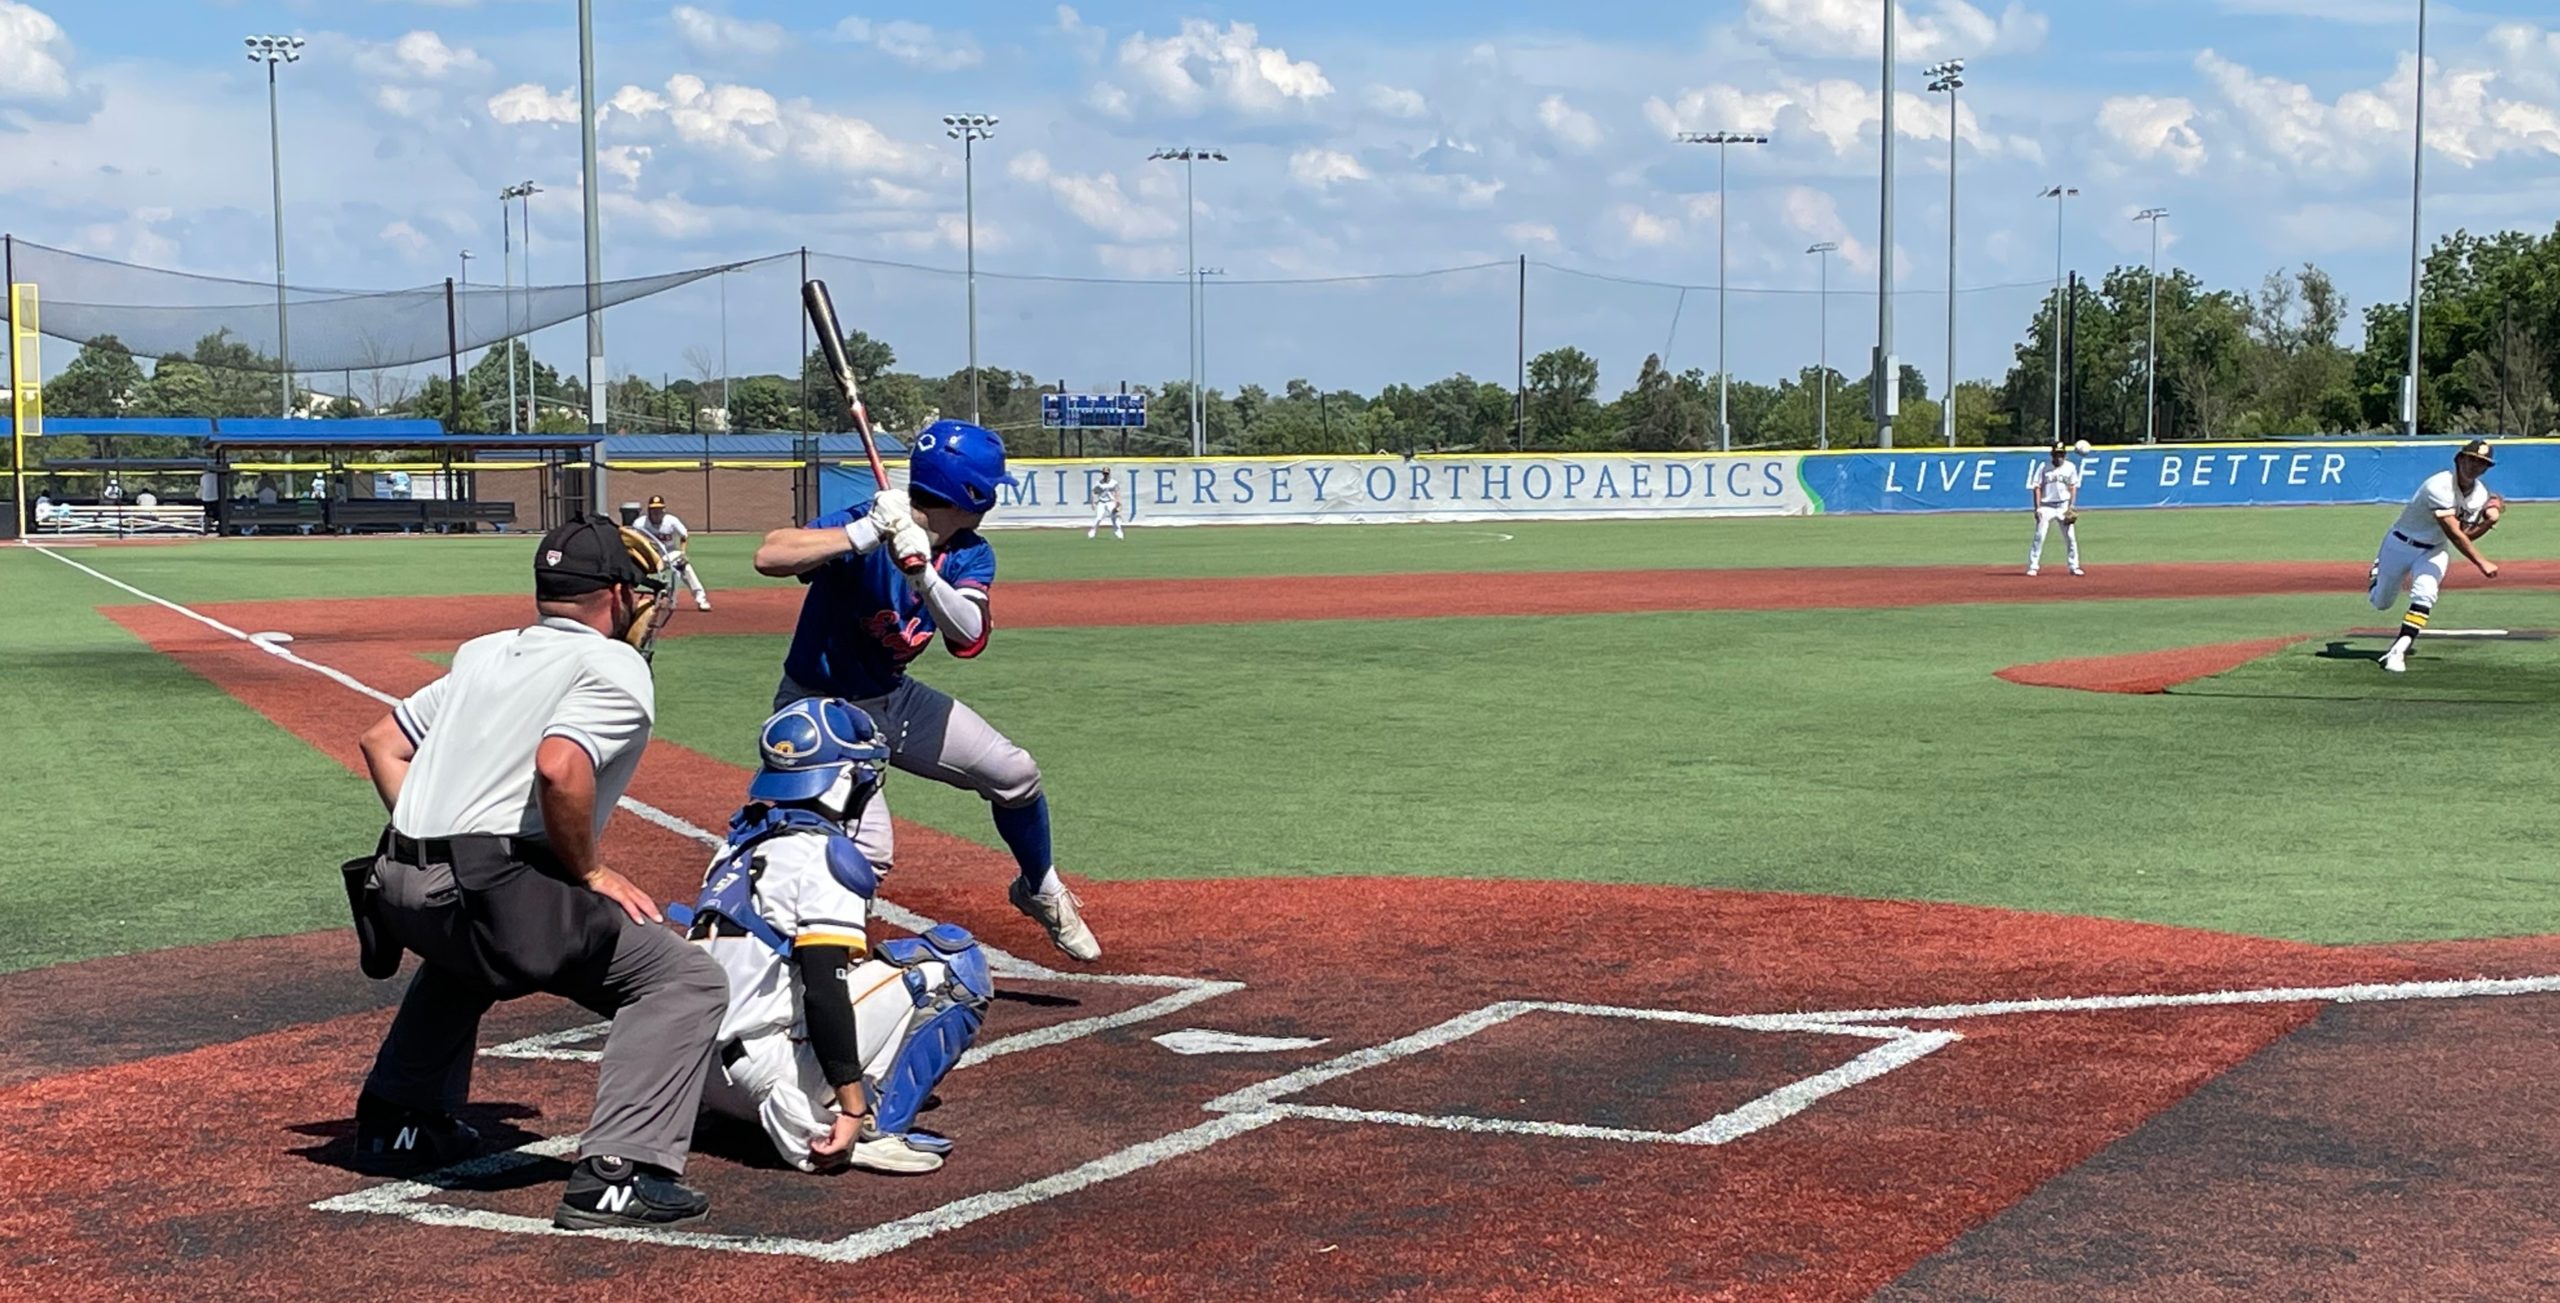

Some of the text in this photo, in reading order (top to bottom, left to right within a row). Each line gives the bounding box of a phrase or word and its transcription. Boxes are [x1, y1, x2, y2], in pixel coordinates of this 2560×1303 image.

[1366, 462, 1784, 501] ORTHOPAEDICS
[1885, 454, 2346, 492] LIVE LFE BETTER
[393, 1126, 418, 1150] N
[596, 1185, 632, 1212] N
